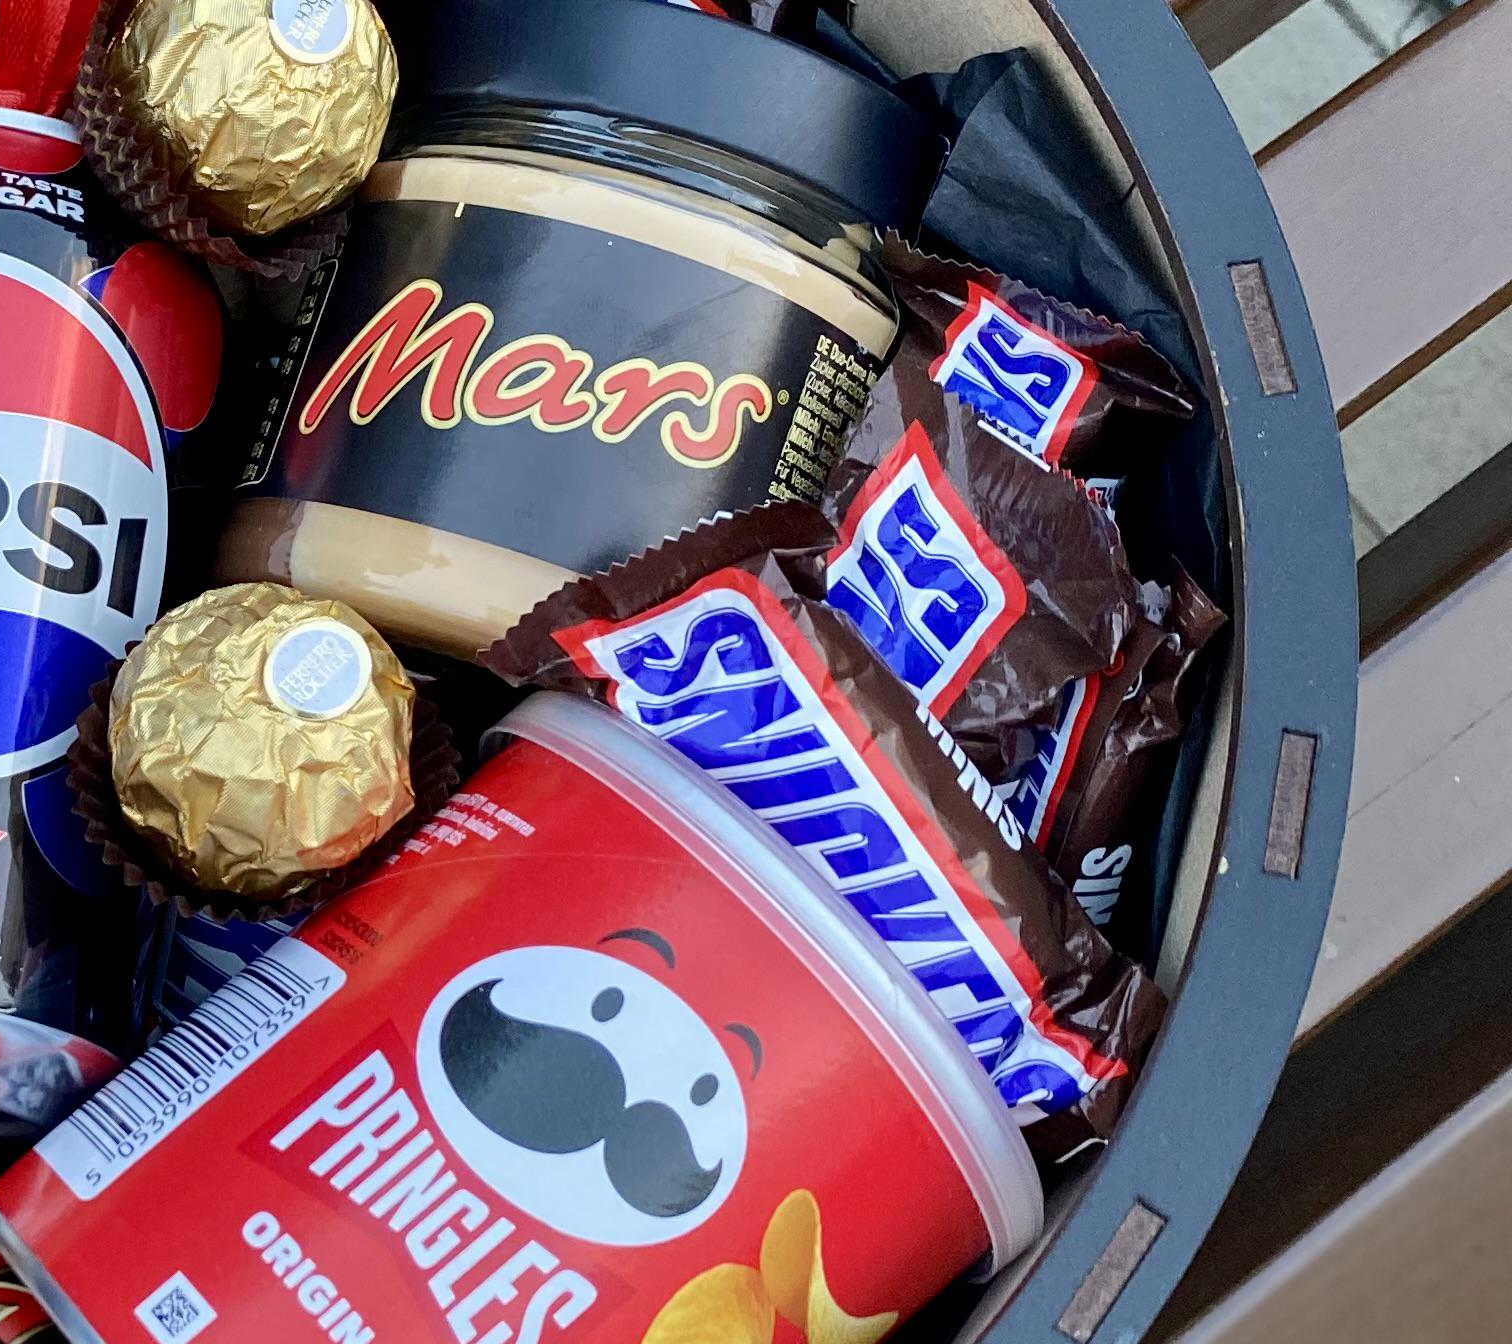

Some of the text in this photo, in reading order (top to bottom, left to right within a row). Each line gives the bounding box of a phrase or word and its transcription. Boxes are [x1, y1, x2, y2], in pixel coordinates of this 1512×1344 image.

[0, 172, 84, 202] TASTE
[299, 278, 772, 468] Mars
[85, 994, 306, 1187] 5 053990 107339
